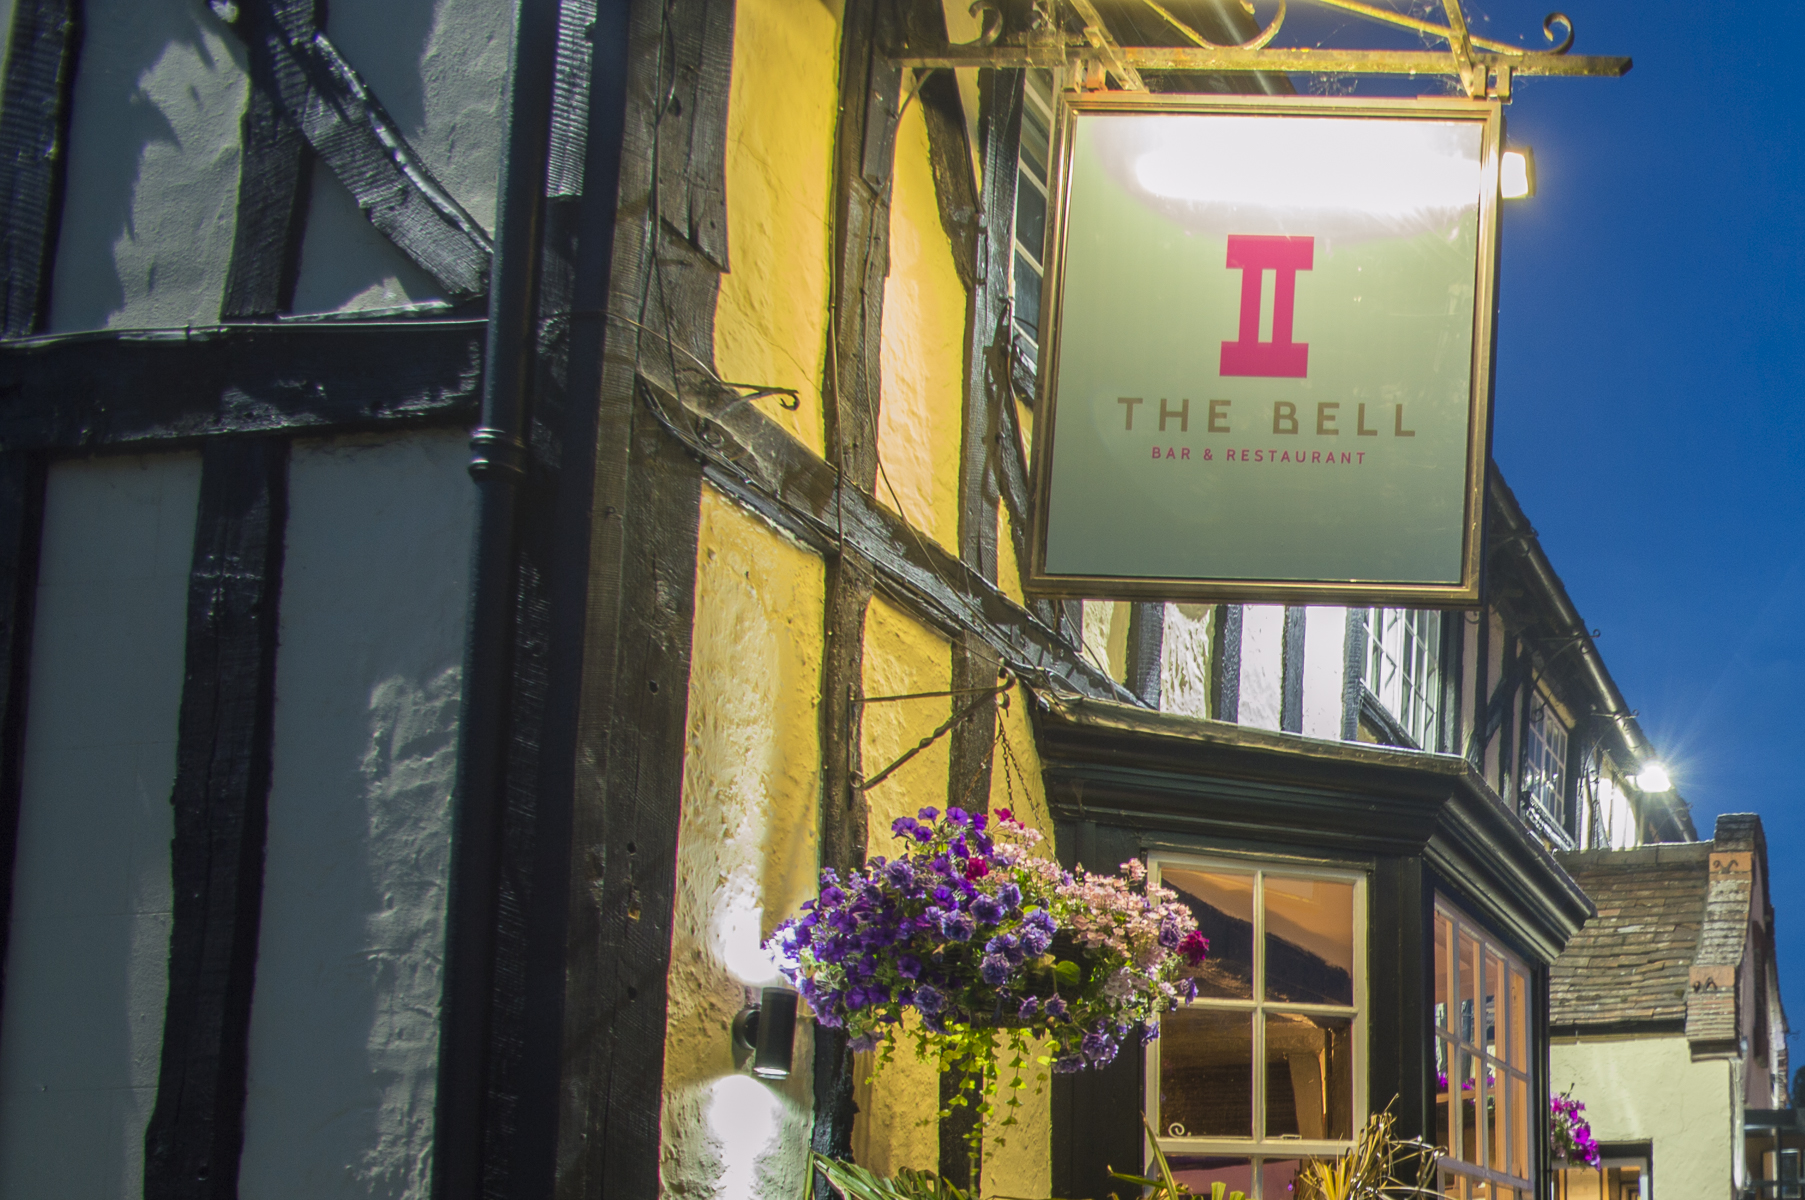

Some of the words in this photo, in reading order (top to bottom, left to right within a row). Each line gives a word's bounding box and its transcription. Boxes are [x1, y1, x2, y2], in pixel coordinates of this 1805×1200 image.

[1117, 397, 1232, 433] THE
[1273, 402, 1416, 437] BELL
[1152, 446, 1192, 461] BAR
[1203, 448, 1214, 461] &
[1227, 449, 1366, 465] RESTAURANT
